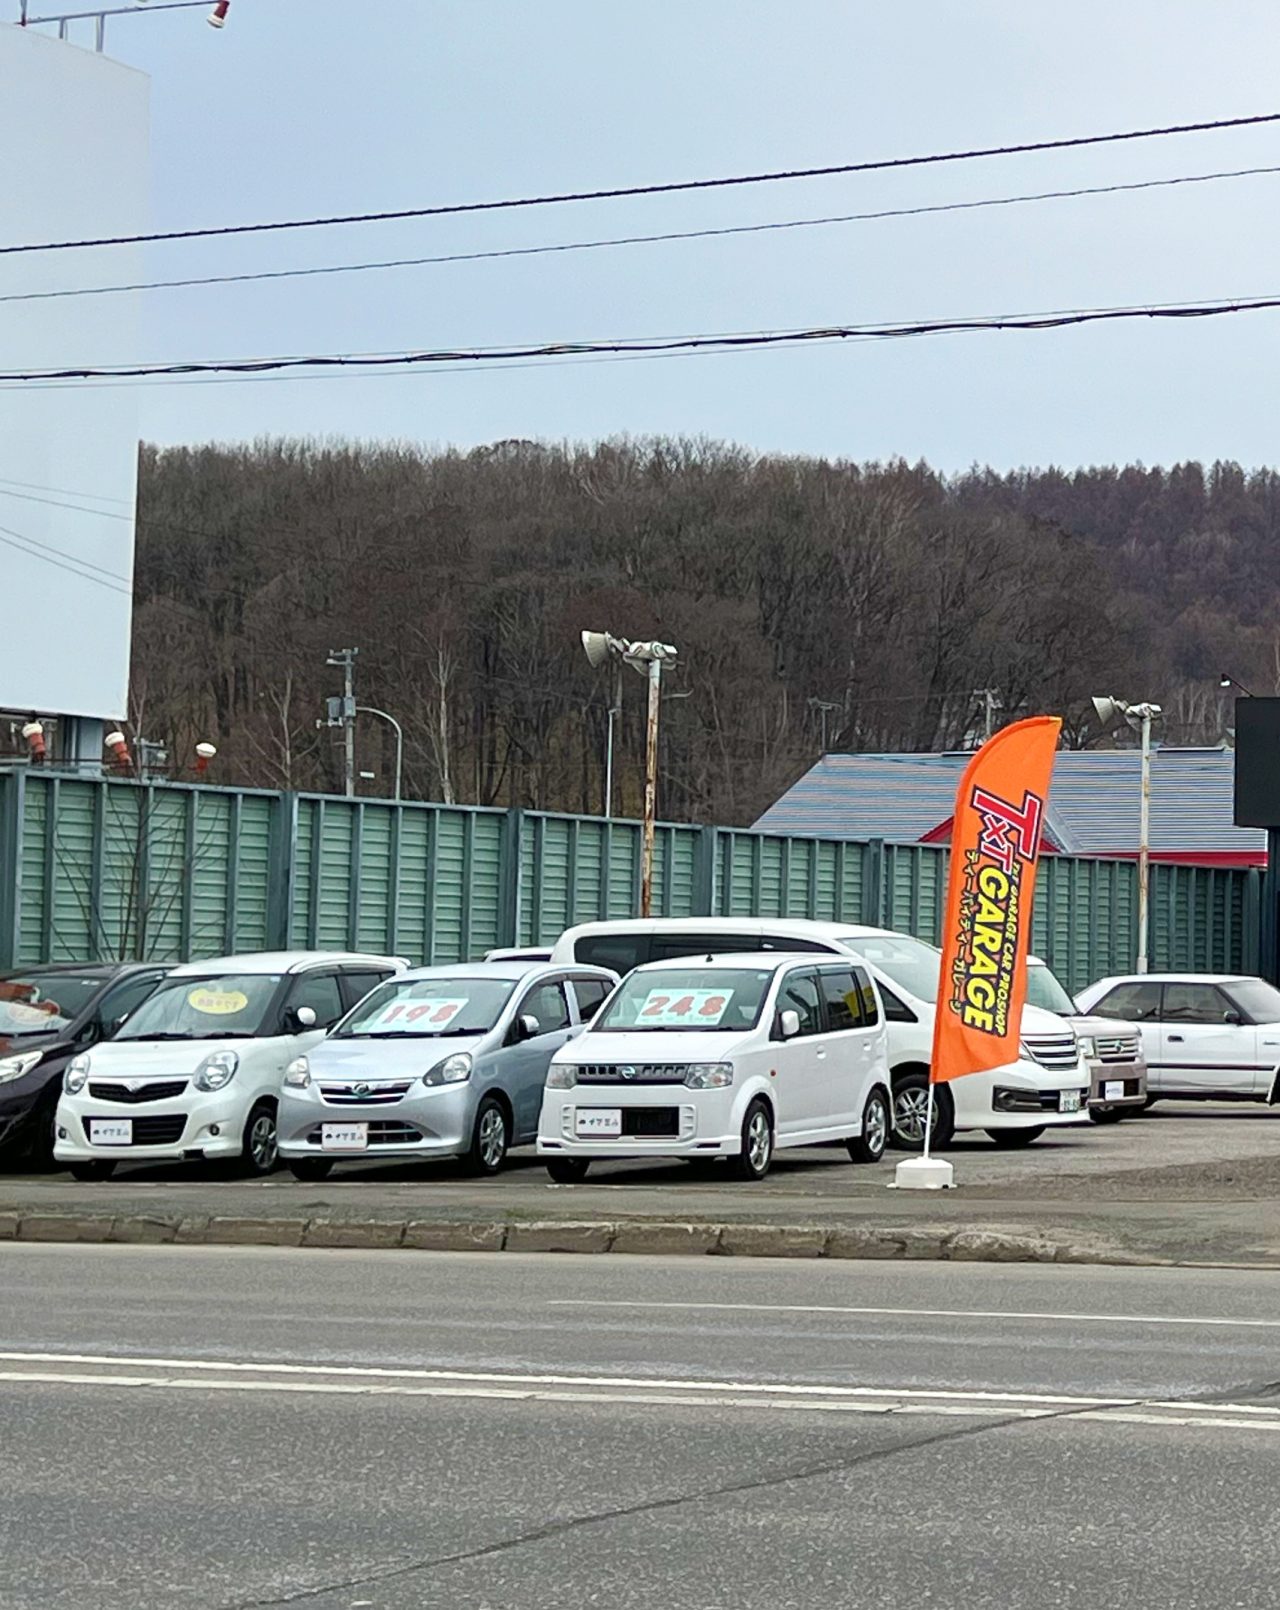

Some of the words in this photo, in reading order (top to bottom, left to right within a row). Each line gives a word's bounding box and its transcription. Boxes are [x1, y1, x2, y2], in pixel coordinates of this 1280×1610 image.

[1004, 885, 1018, 941] GARAGE
[963, 865, 1009, 1032] GARAGE
[1002, 943, 1014, 969] CAR
[641, 996, 726, 1016] 248
[995, 971, 1011, 1036] PROSHOP
